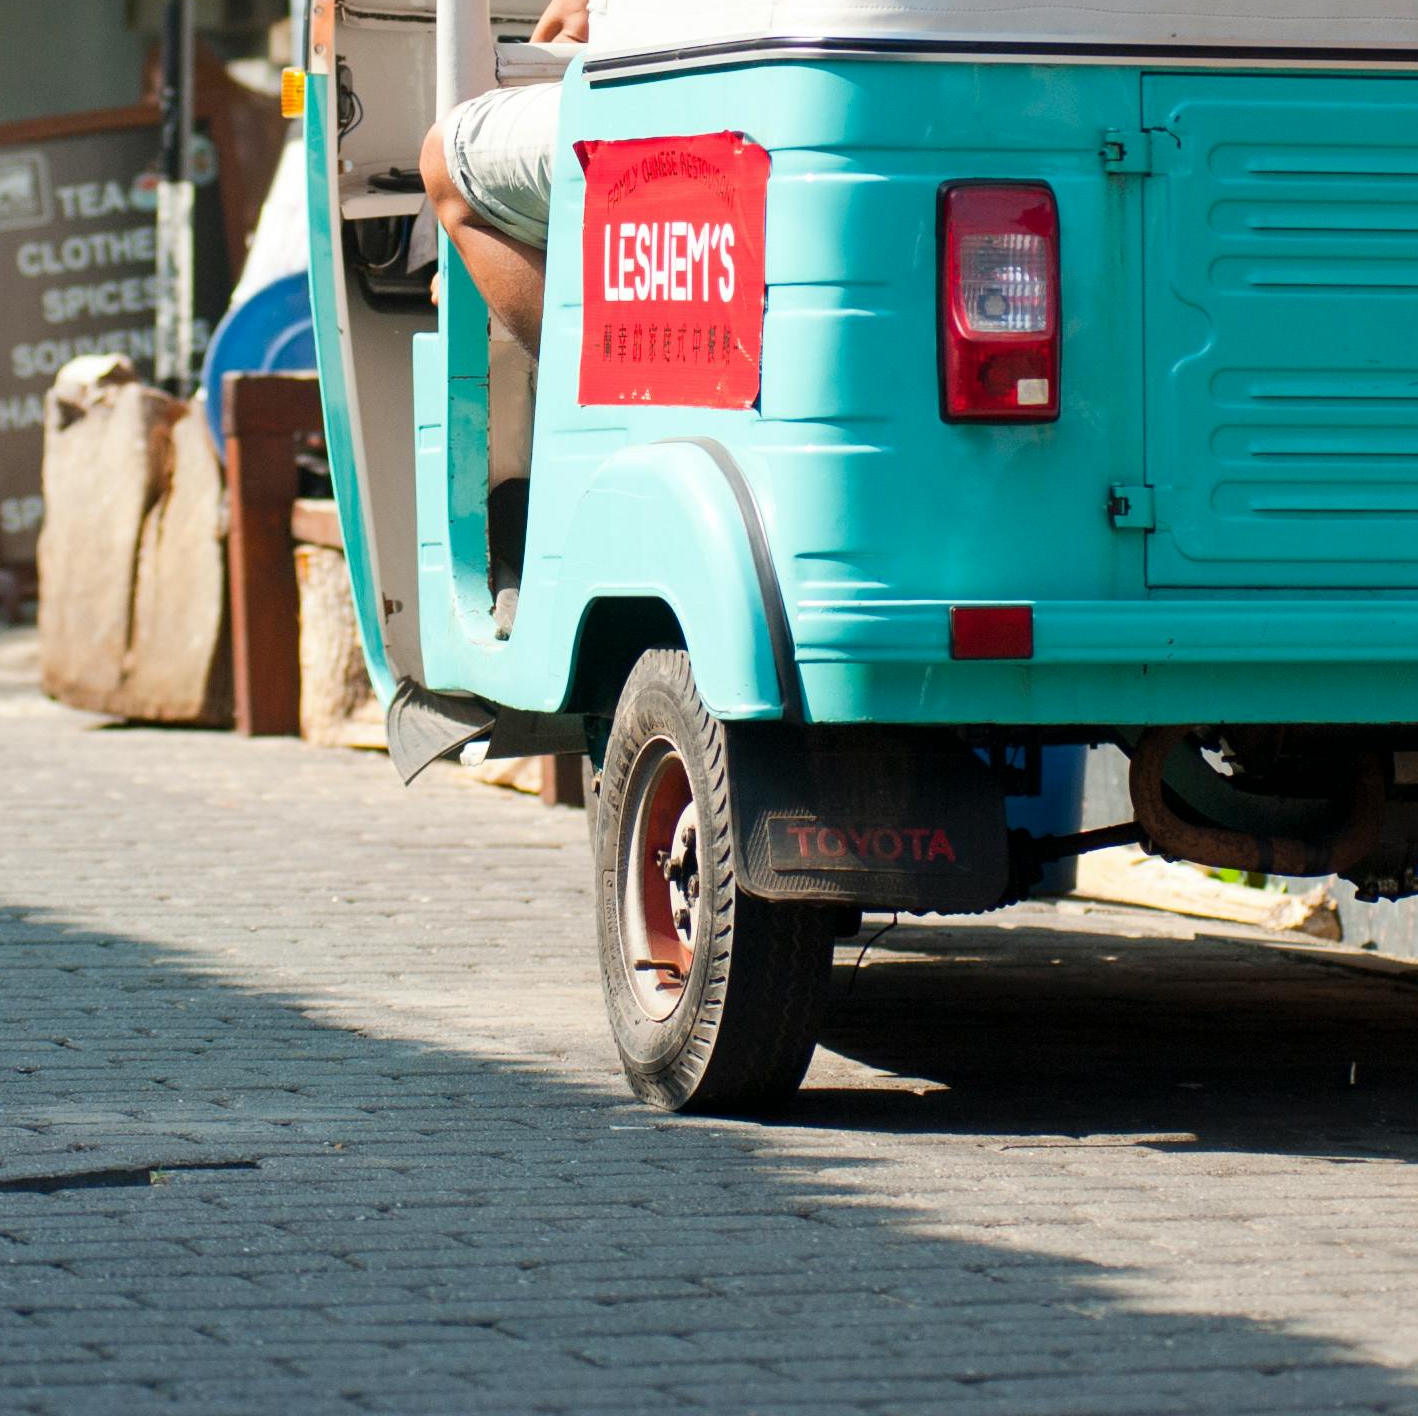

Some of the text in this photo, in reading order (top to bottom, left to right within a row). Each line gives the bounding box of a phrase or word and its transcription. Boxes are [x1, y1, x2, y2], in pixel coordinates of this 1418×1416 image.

[57, 180, 128, 219] TEA
[603, 221, 736, 303] LESHEM'S
[788, 826, 956, 863] TOYOTA
